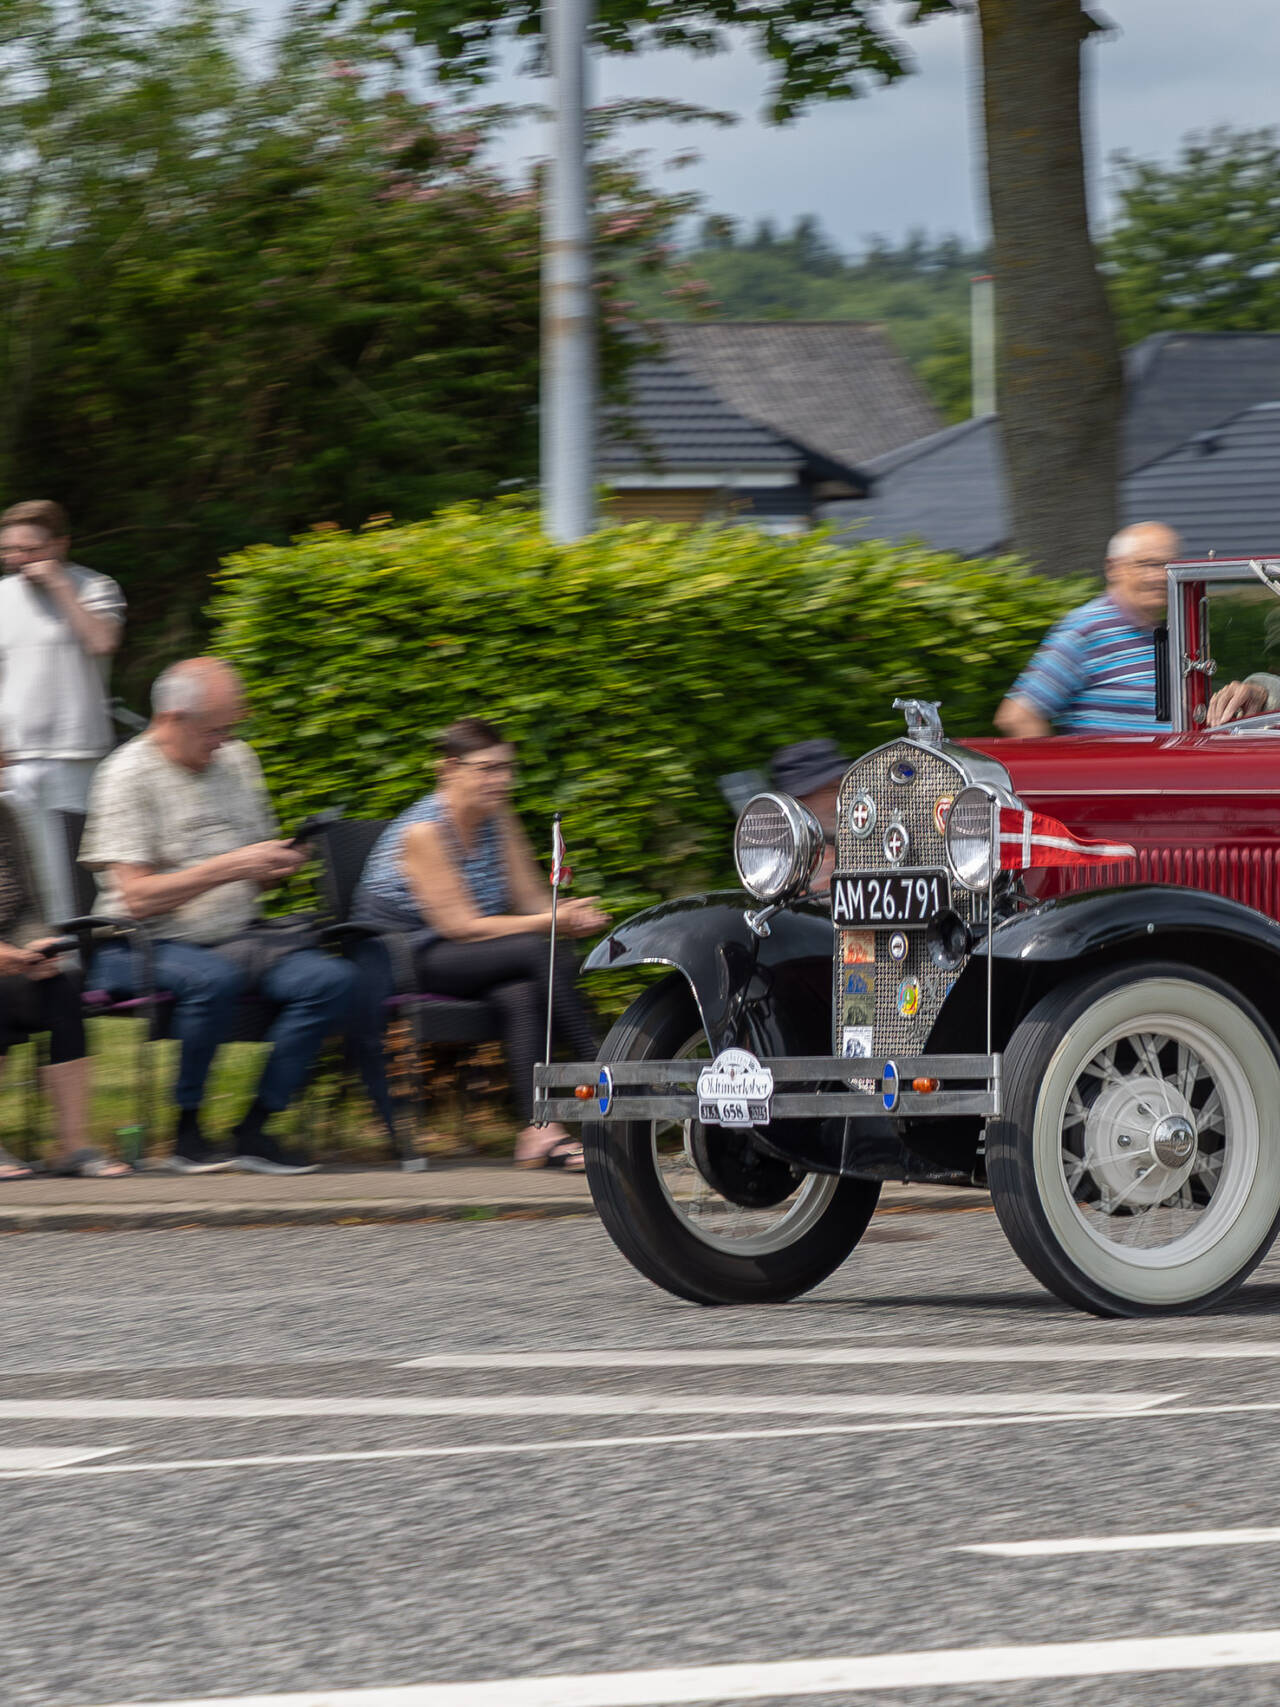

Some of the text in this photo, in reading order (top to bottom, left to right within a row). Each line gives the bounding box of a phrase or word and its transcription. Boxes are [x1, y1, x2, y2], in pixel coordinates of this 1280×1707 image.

[833, 877, 940, 920] AM 26.791
[723, 1103, 744, 1121] 658
